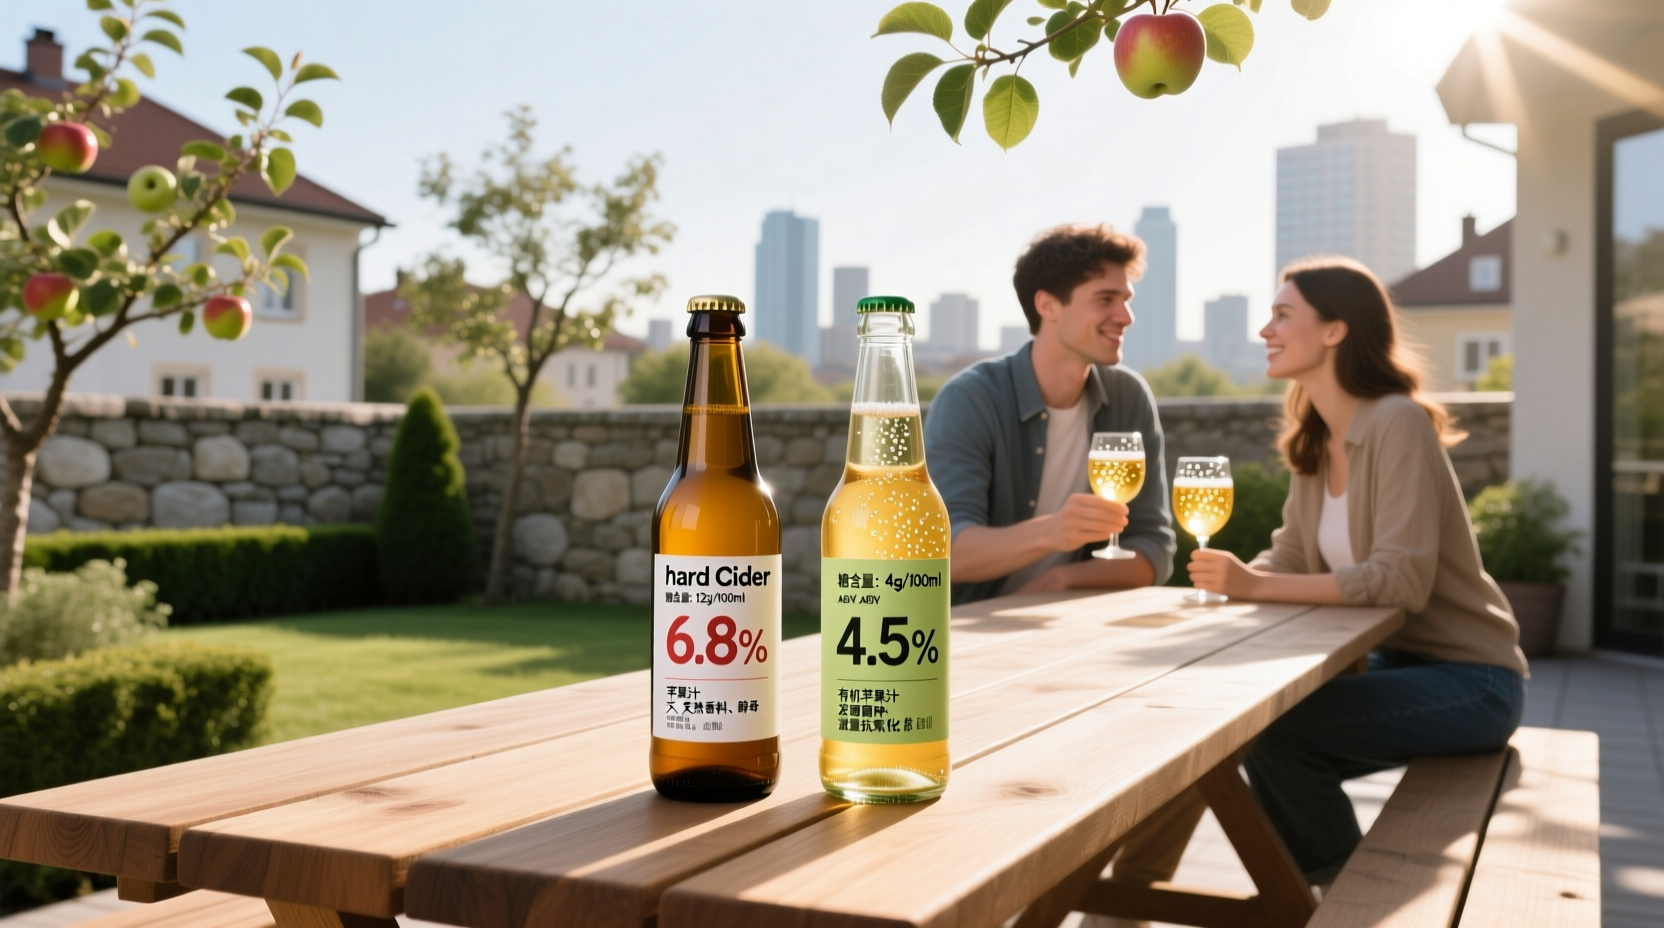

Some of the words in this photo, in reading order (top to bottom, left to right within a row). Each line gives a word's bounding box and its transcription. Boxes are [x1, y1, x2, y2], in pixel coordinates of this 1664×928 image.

[665, 565, 710, 587] hard
[715, 565, 771, 587] Cider
[885, 572, 942, 592] 4g/100ml
[666, 615, 768, 666] 6.8%
[836, 616, 939, 666] 4.5%
